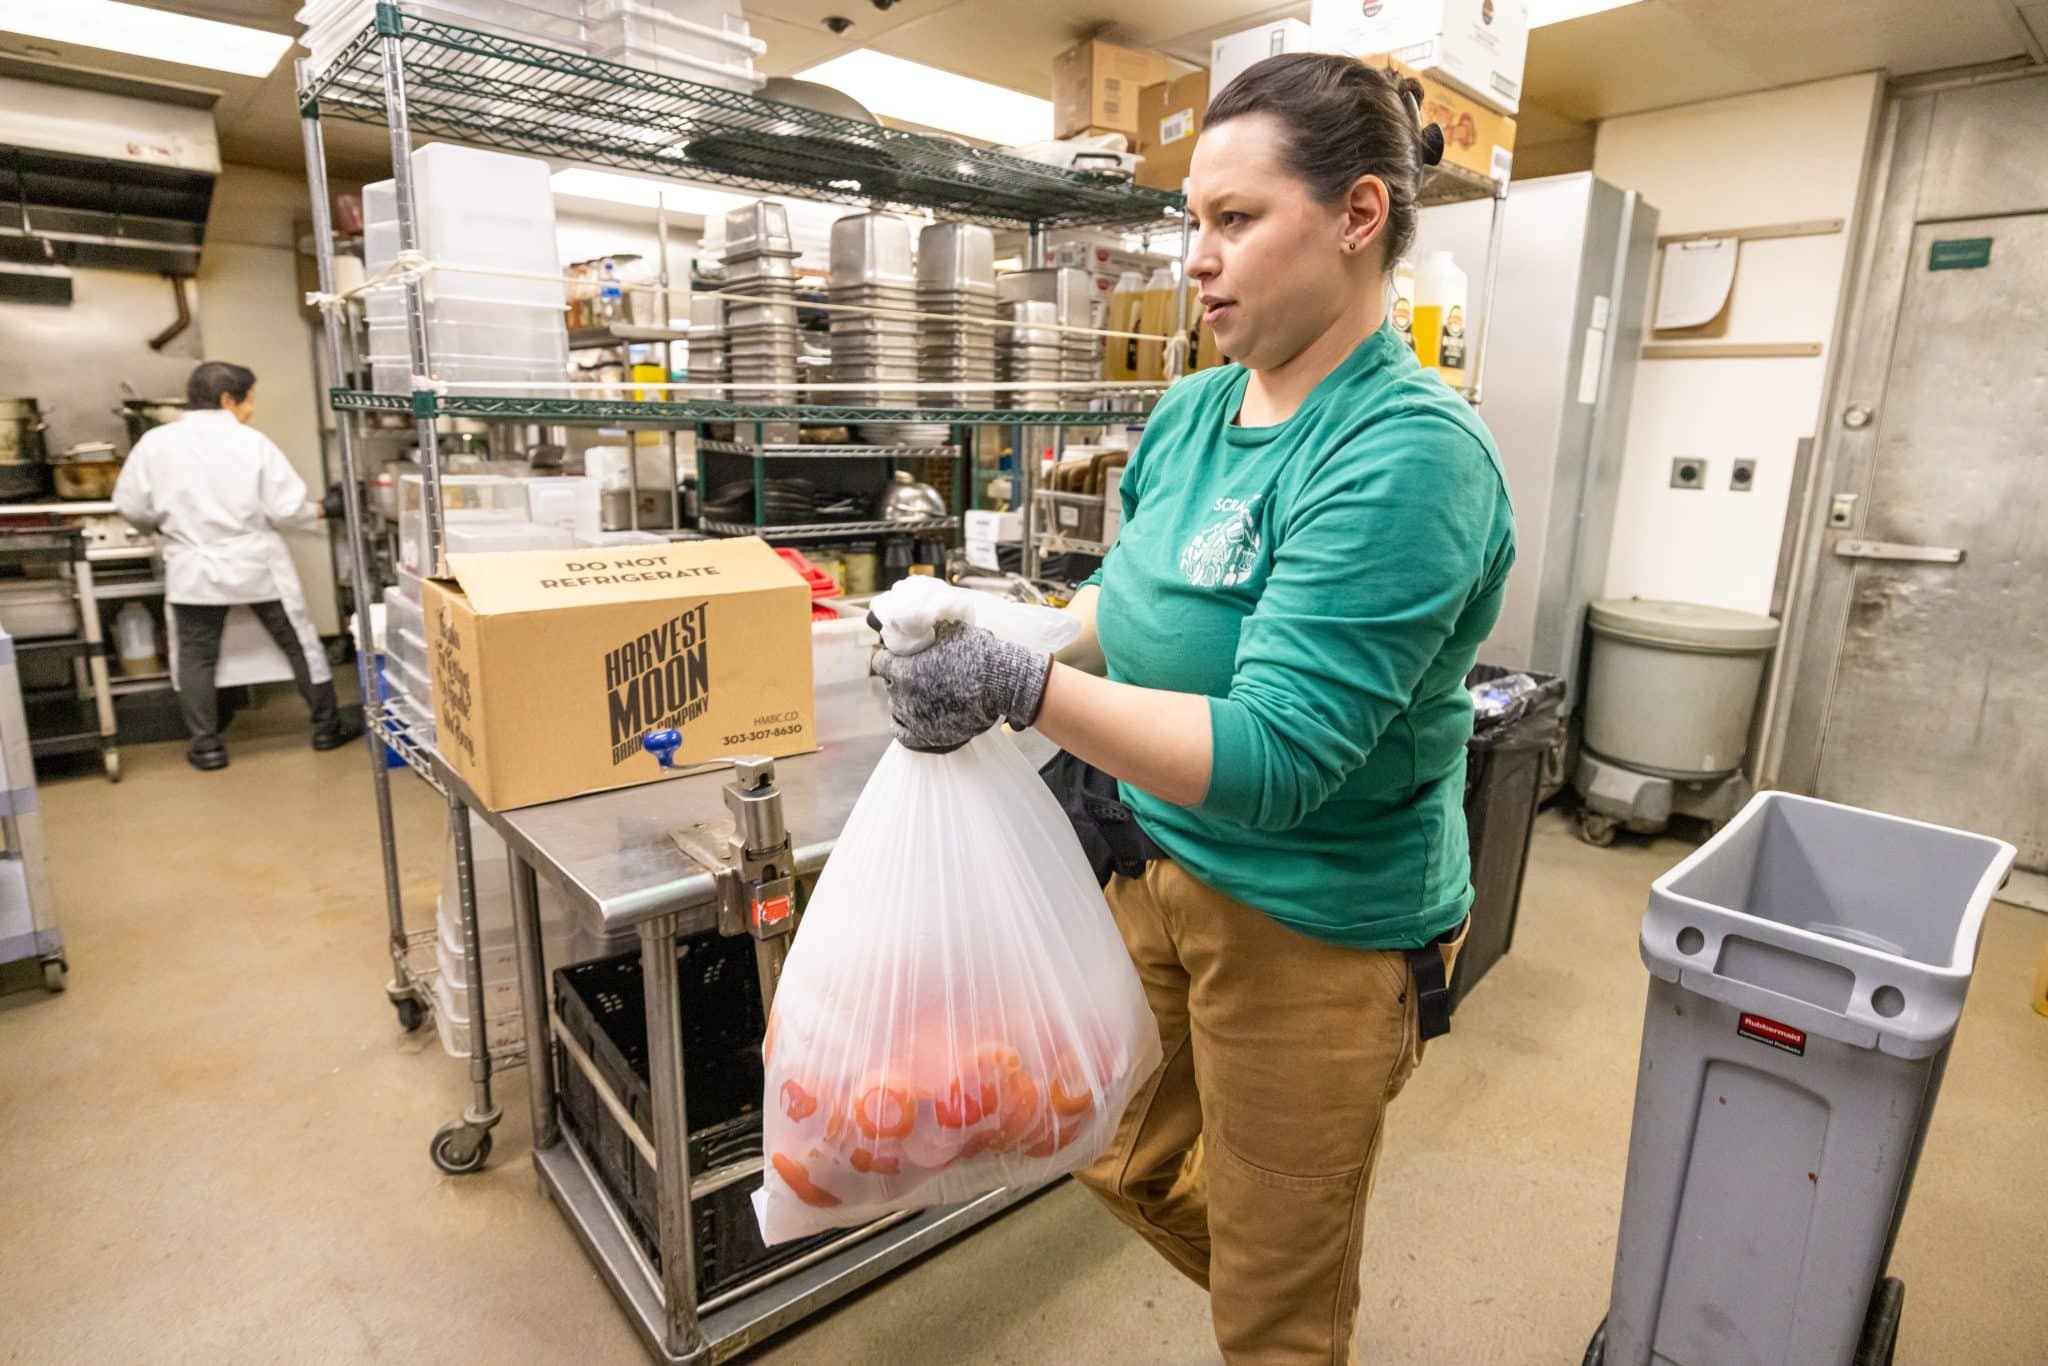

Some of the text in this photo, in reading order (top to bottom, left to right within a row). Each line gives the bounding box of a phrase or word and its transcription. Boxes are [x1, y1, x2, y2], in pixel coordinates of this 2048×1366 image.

[565, 556, 668, 572] DO NOT
[539, 566, 721, 589] REFRIGERATE
[604, 601, 709, 692] HARVEST
[608, 640, 709, 748] MOON
[612, 728, 651, 767] BAKIN
[722, 724, 802, 746] 303-307-8630
[1744, 1016, 1801, 1042] Rubbermaid
